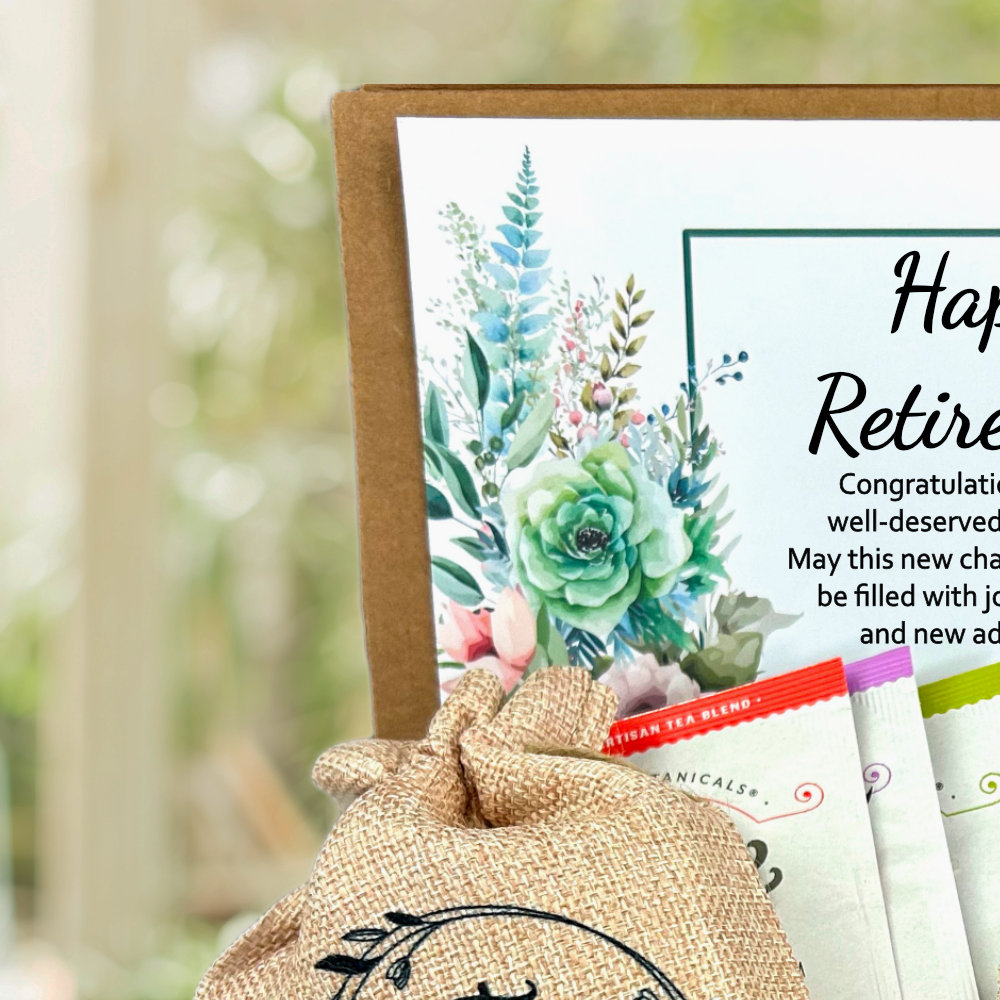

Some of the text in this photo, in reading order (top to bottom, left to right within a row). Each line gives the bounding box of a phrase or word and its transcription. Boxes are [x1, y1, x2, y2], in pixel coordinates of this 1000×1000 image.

[788, 547, 842, 576] May
[847, 545, 894, 570] this
[901, 552, 953, 570] new
[818, 583, 848, 608] be
[854, 582, 915, 608] filled
[922, 583, 977, 608] with
[860, 620, 906, 645] and
[914, 627, 967, 645] new
[604, 698, 752, 749] RTISAN TEA BLEND
